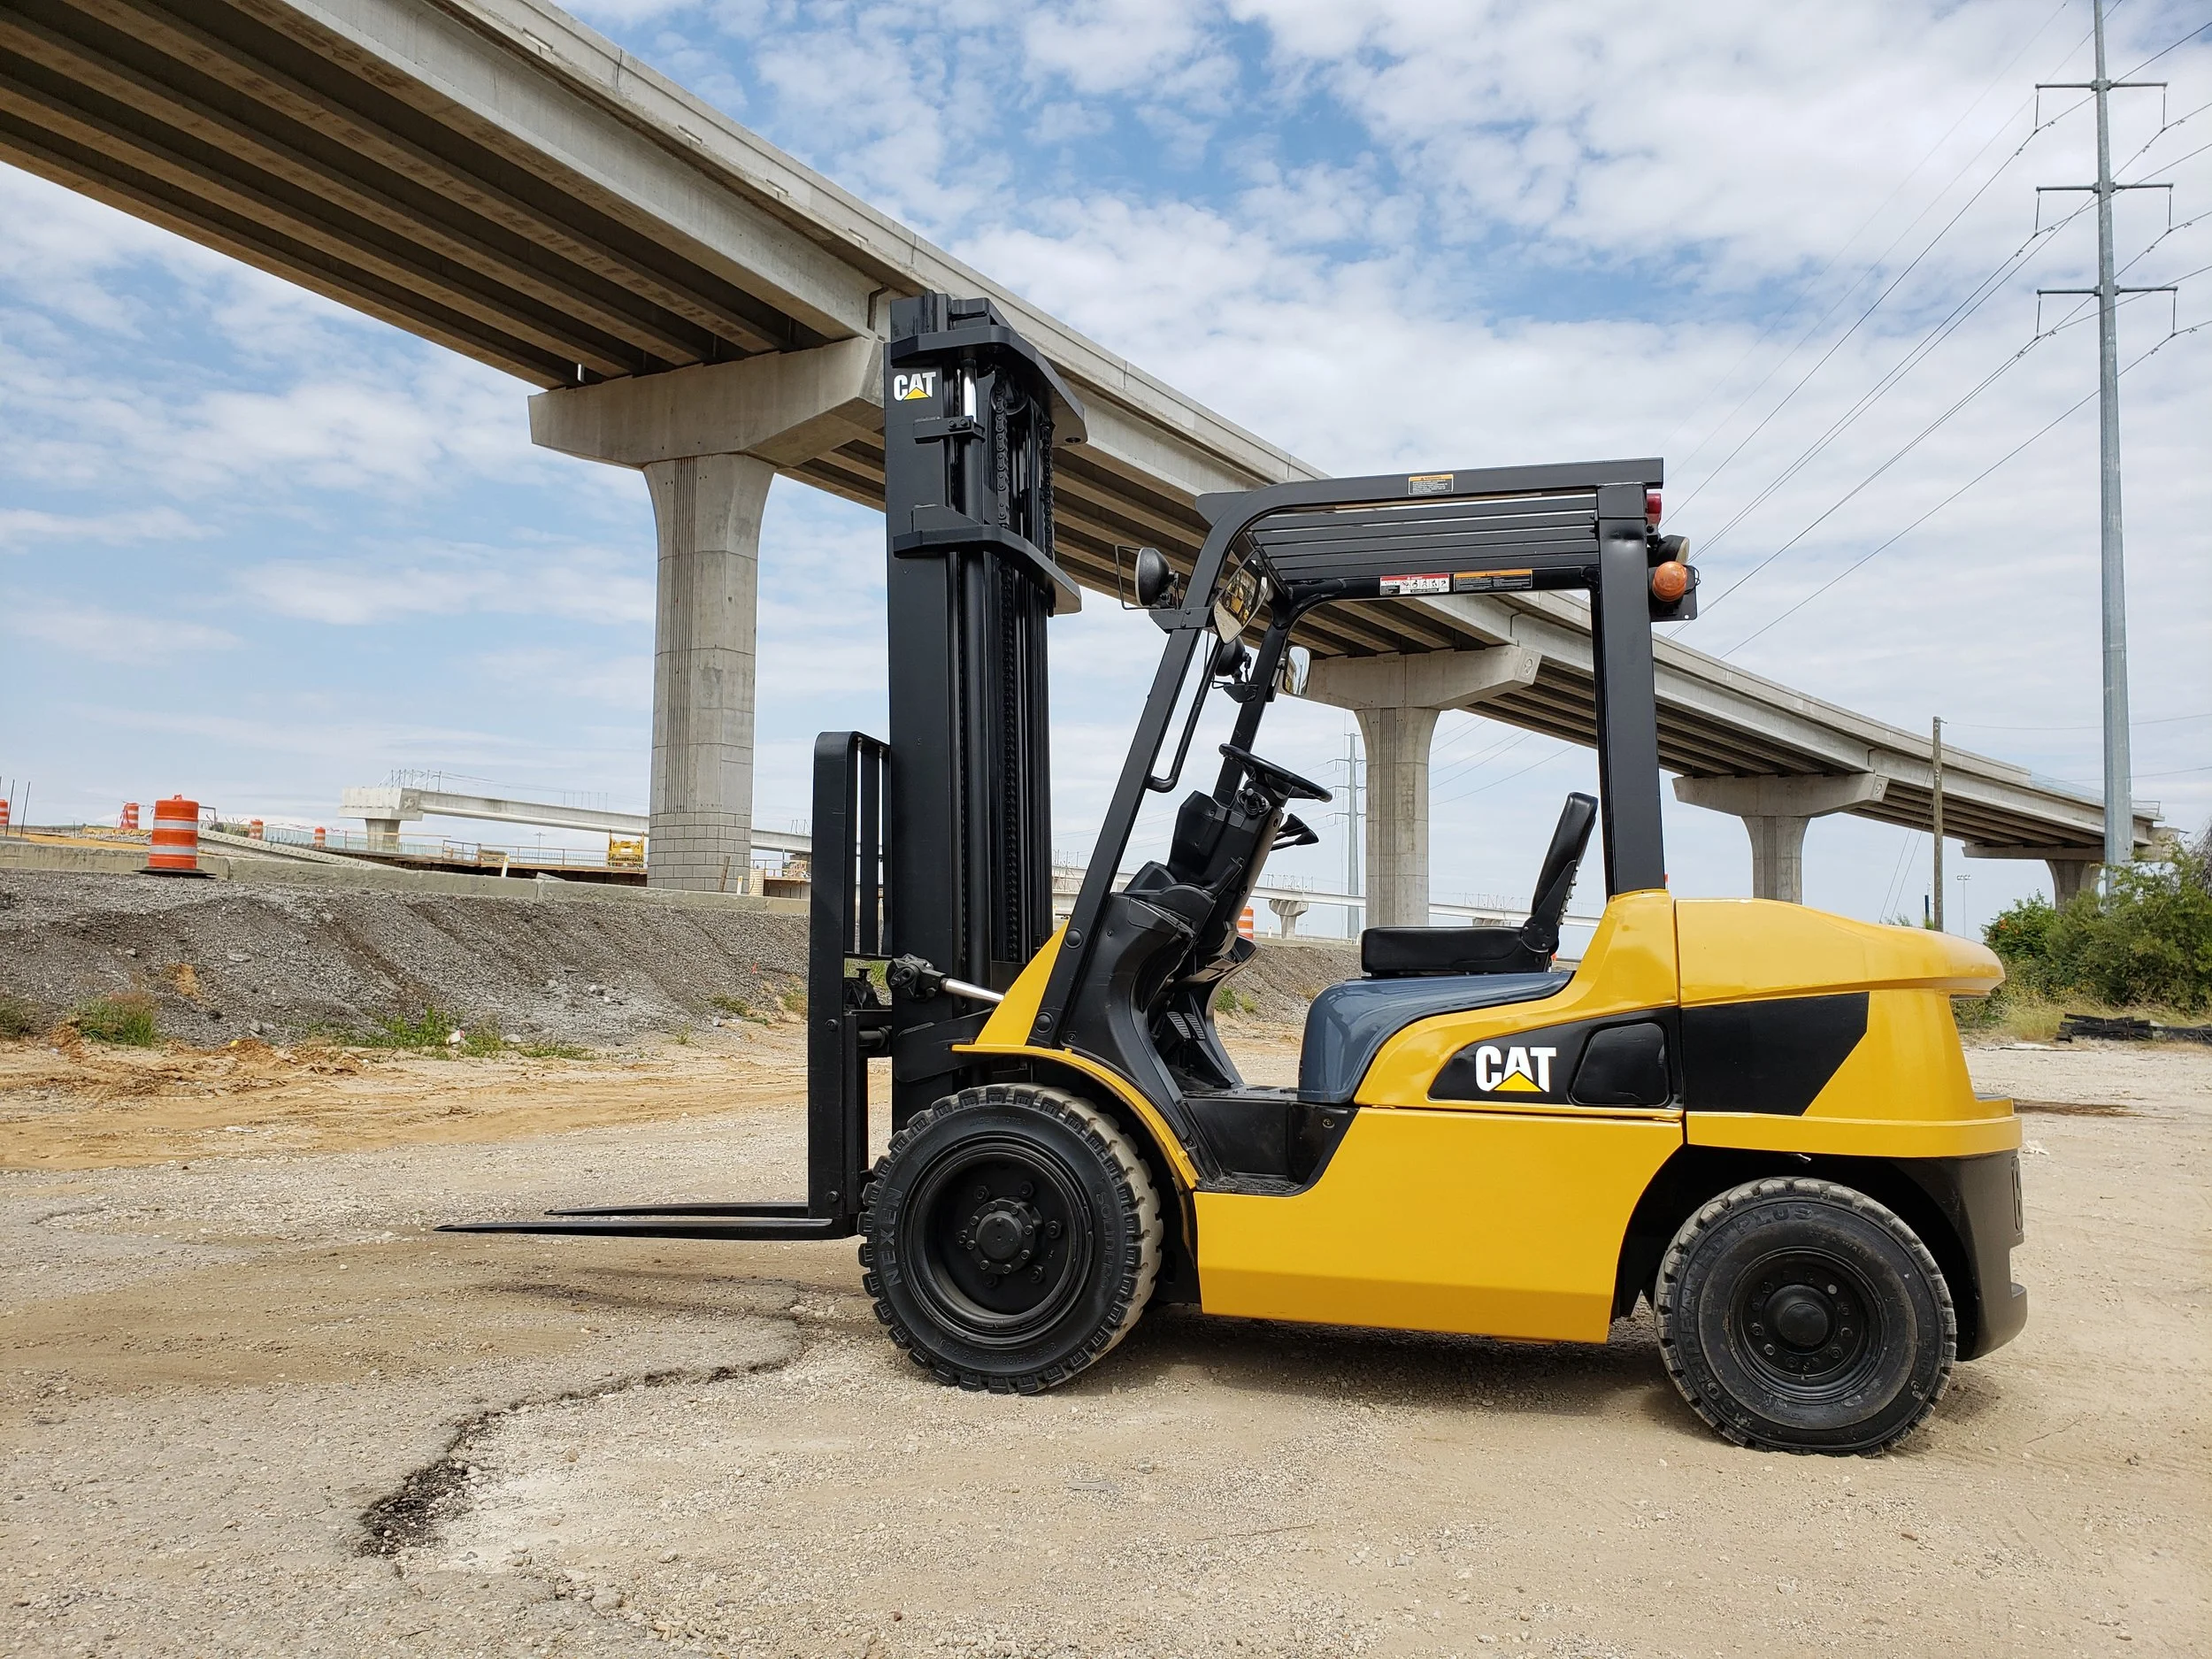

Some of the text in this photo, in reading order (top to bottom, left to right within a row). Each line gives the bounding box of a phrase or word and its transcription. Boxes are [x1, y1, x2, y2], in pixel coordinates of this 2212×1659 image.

[894, 372, 937, 402] CAT
[1475, 1045, 1557, 1093] CAT
[879, 1187, 903, 1287] NEXEN
[1734, 1204, 1814, 1235] PLUS
